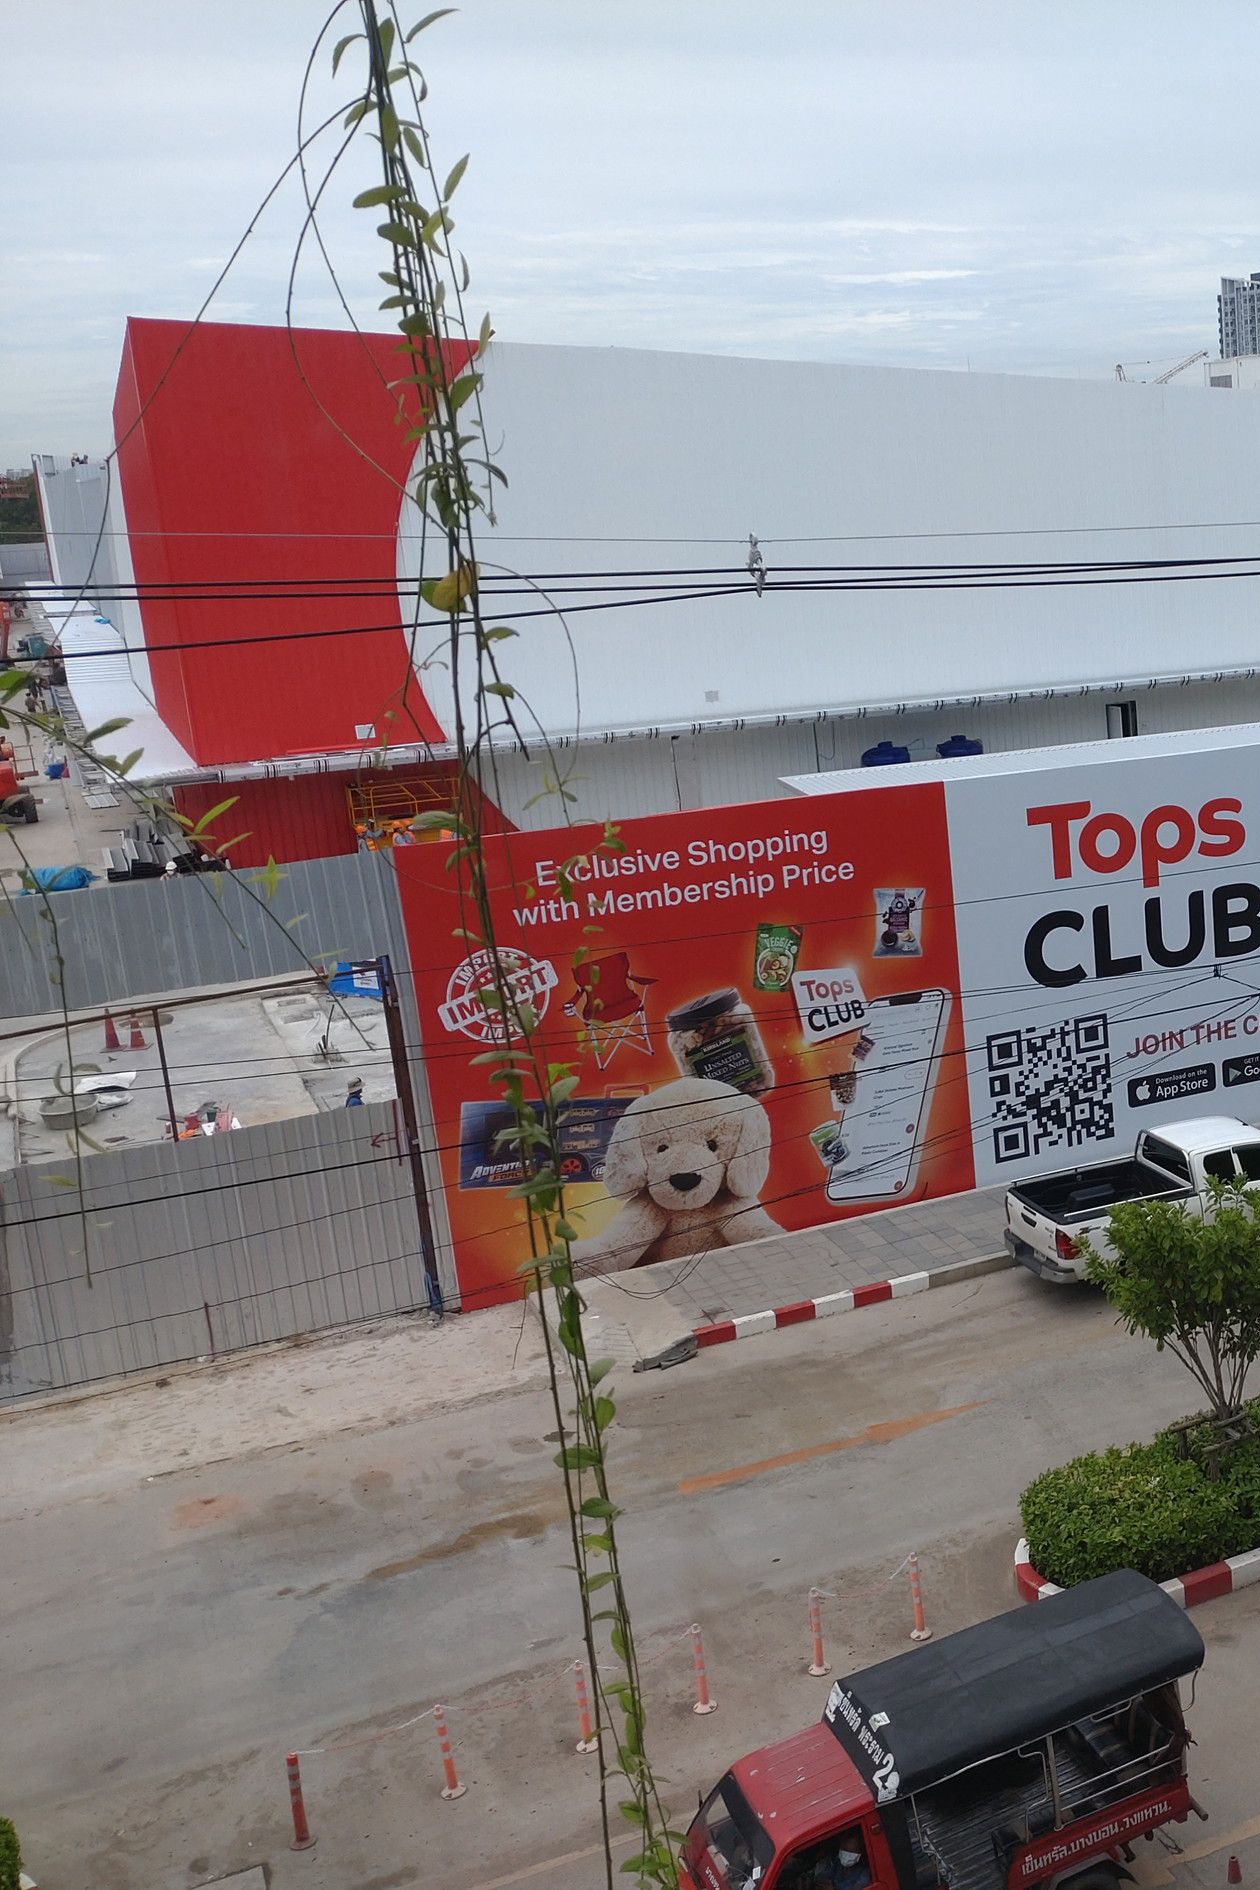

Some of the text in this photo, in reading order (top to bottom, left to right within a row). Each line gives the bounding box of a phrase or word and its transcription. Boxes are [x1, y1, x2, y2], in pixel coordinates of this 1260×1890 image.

[535, 829, 828, 887] Exclusive Shopping
[1026, 798, 1246, 888] Tops
[512, 861, 855, 927] with Membership Price
[446, 966, 548, 1026] IMRT
[799, 979, 855, 1002] Tops
[807, 999, 866, 1032] CLUB
[1126, 1028, 1185, 1058] JOIN
[1190, 1019, 1237, 1045] THE
[1155, 1068, 1208, 1084] Download on the
[1156, 1077, 1209, 1098] App Store
